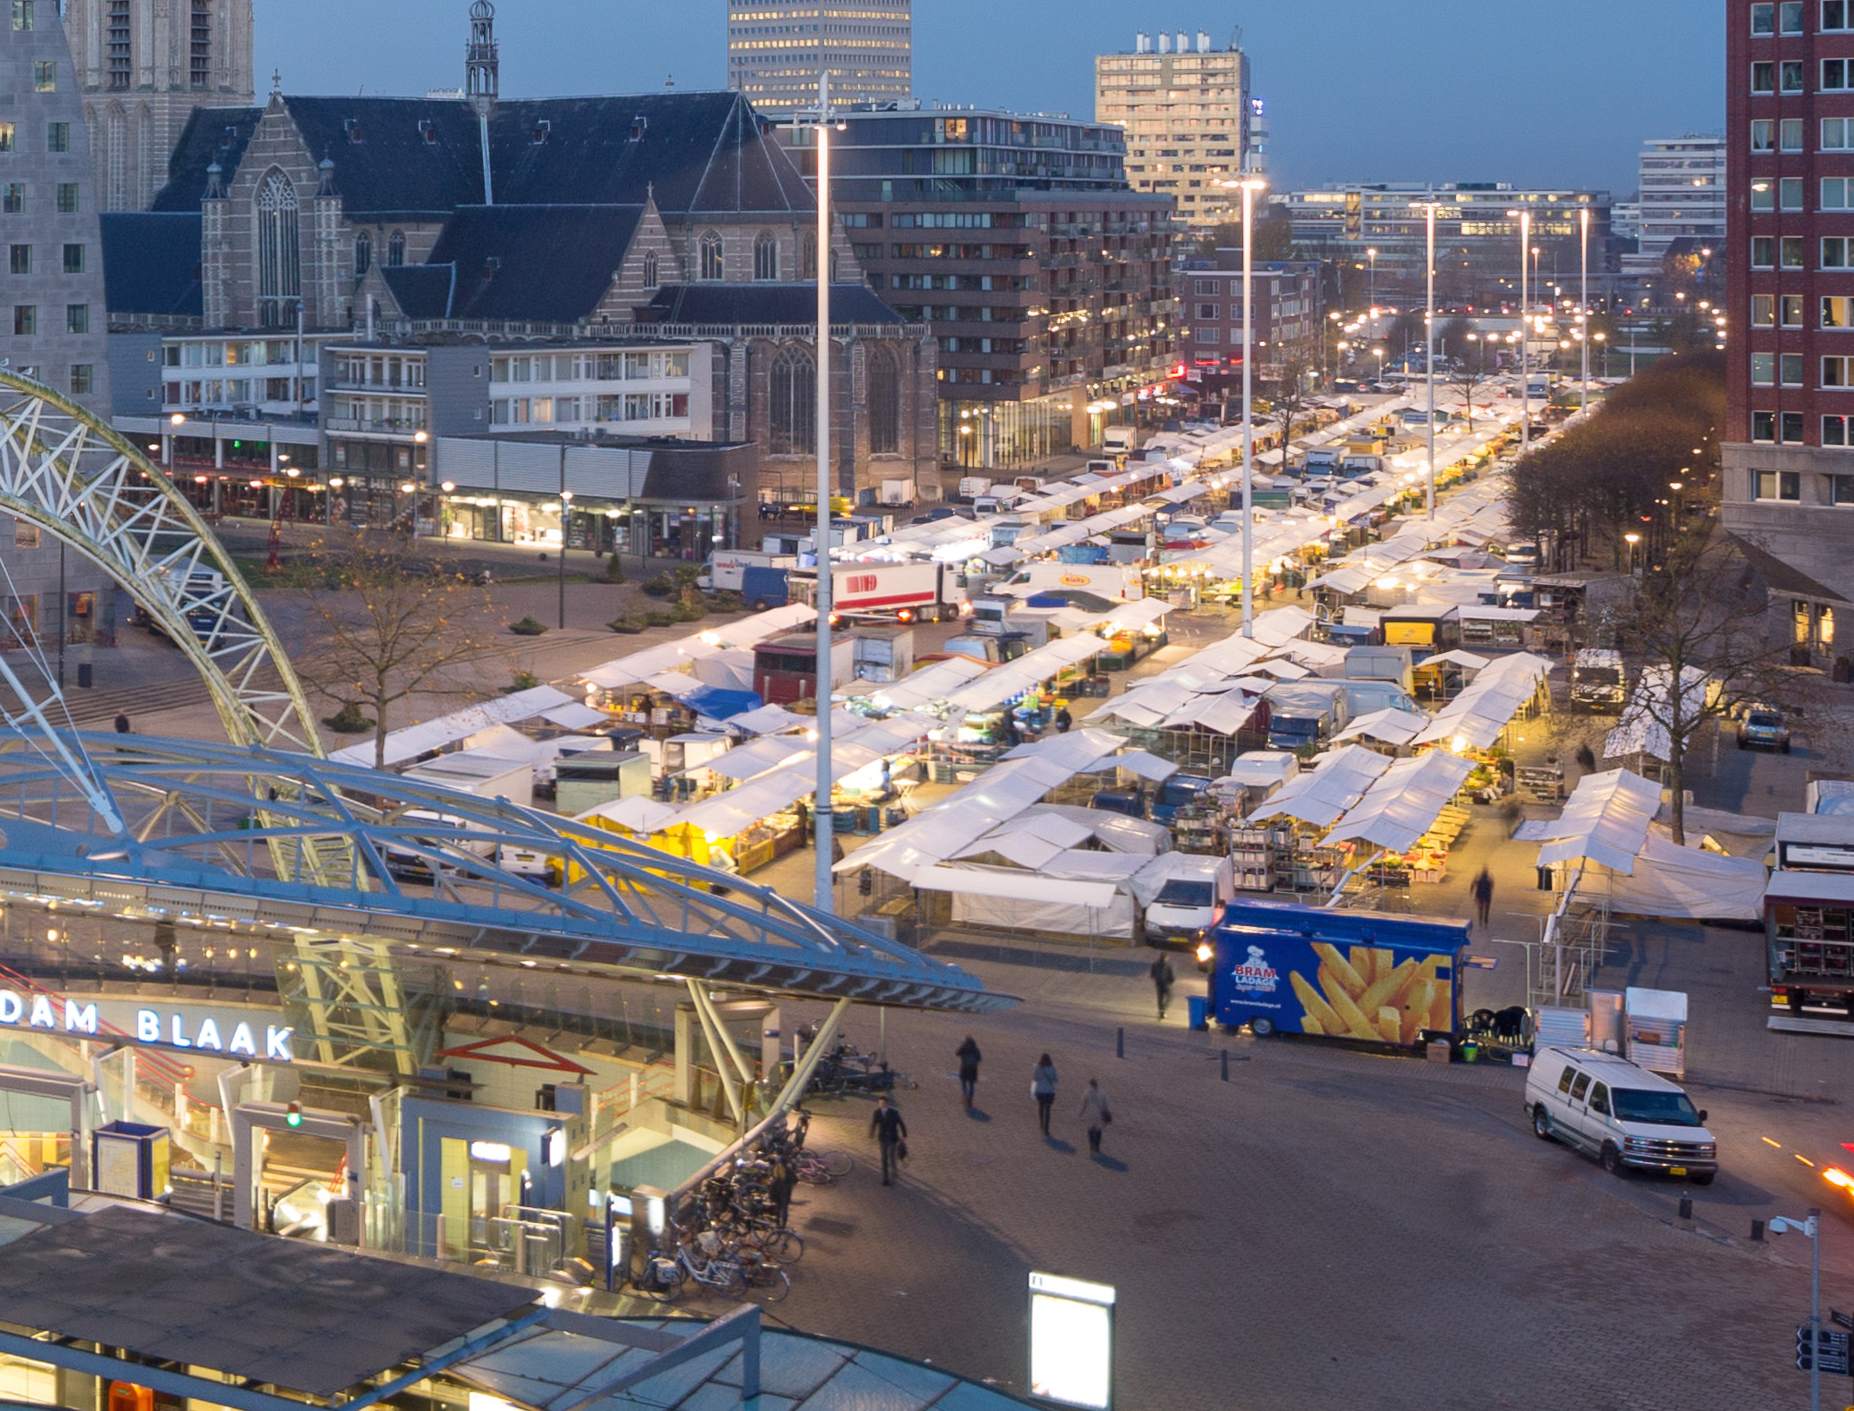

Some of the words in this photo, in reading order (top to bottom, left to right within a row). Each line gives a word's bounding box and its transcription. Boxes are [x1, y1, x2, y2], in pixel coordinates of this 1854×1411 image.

[1234, 964, 1276, 979] BRAM
[1235, 975, 1276, 987] LADAGE
[136, 1008, 293, 1061] BLAAK
